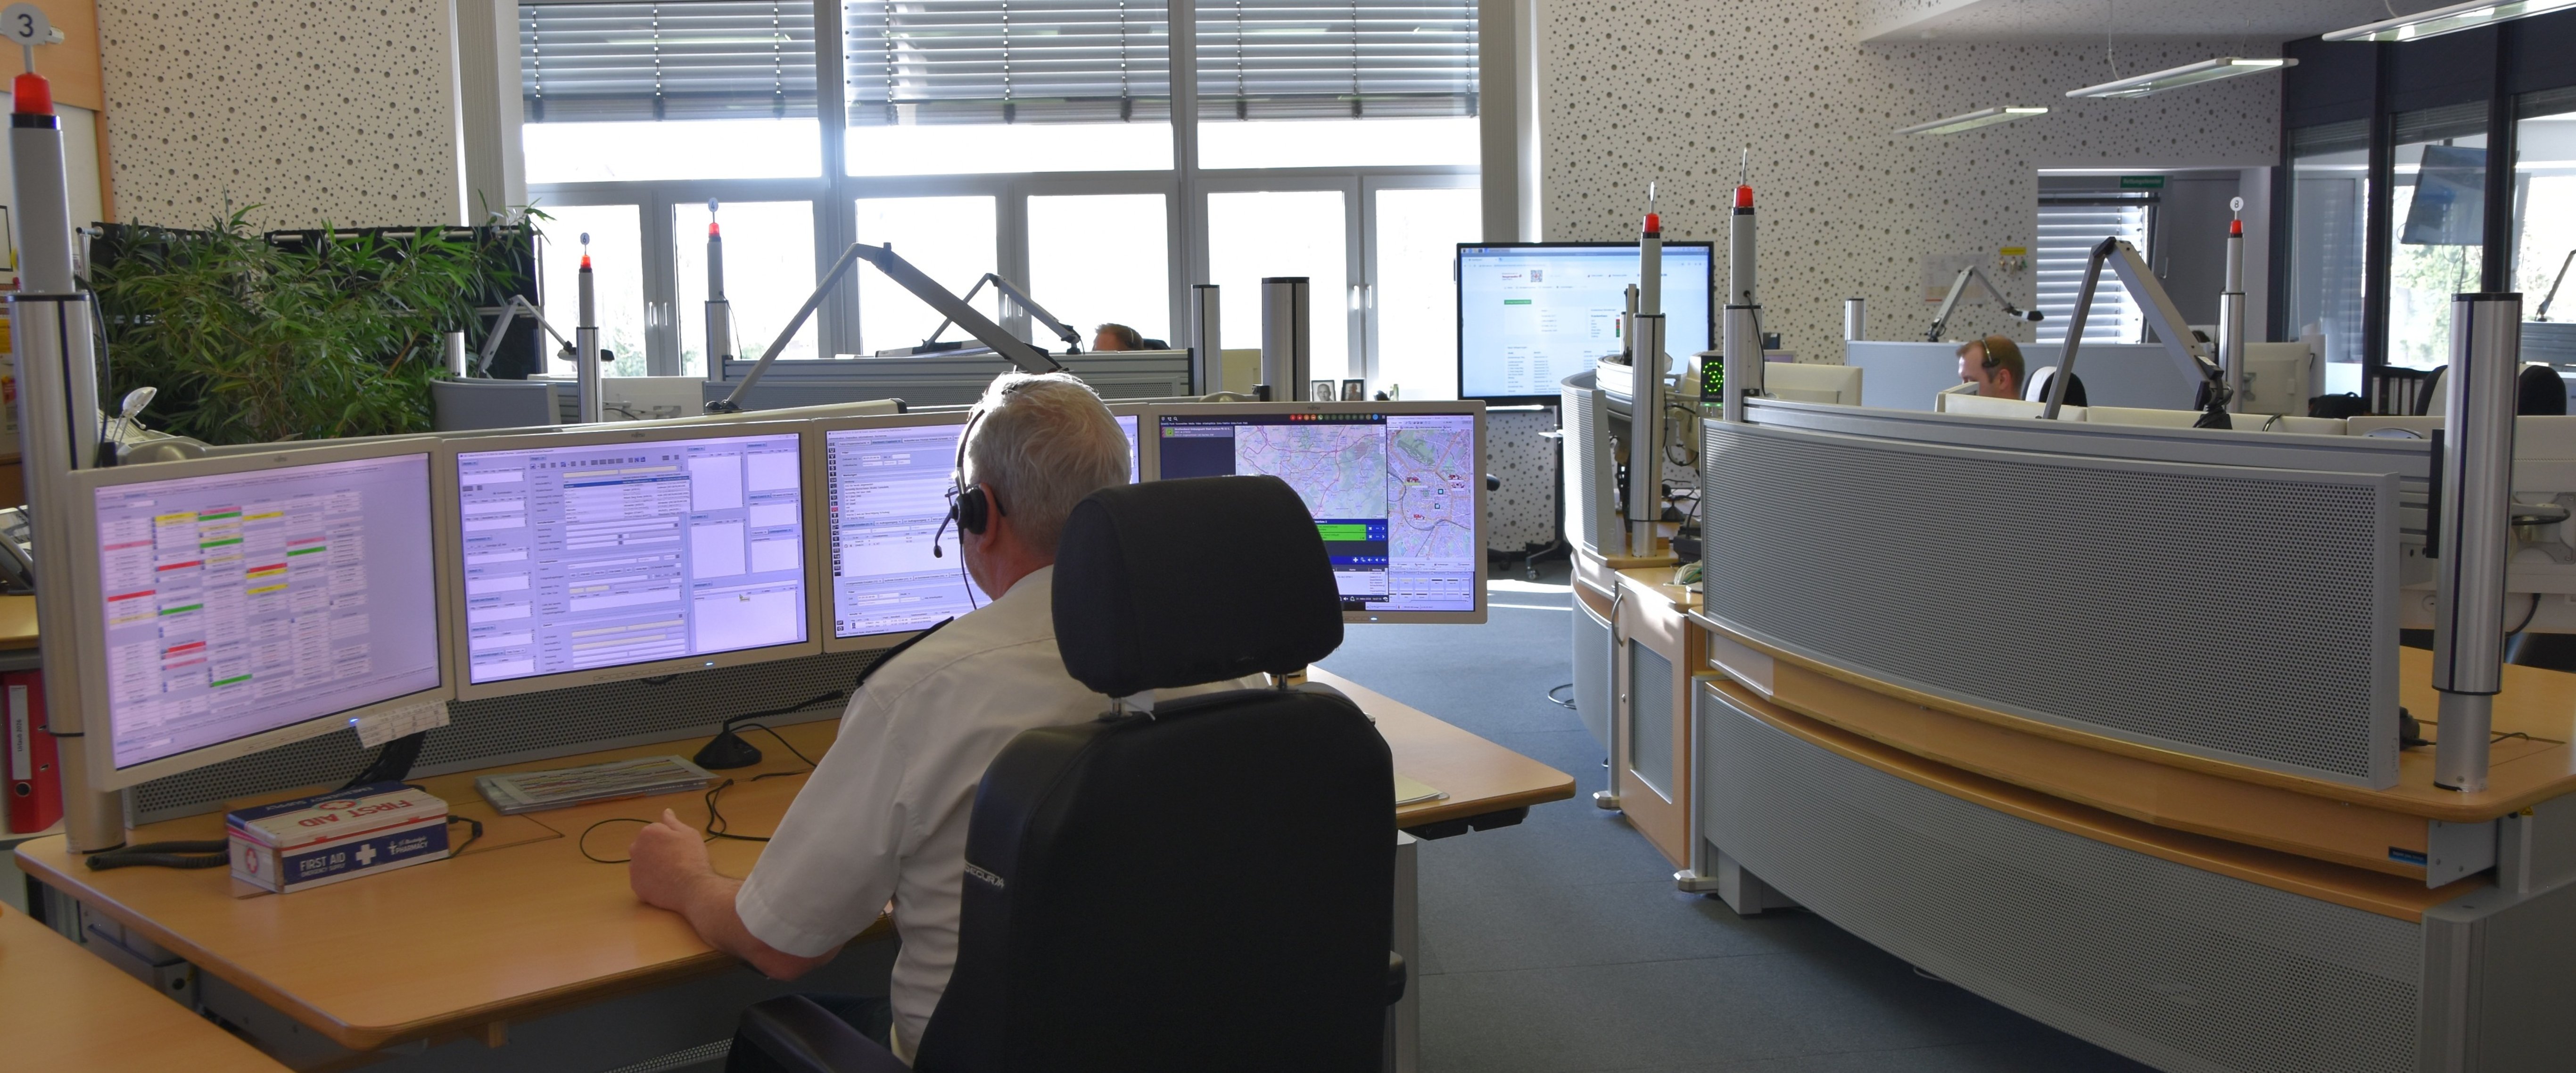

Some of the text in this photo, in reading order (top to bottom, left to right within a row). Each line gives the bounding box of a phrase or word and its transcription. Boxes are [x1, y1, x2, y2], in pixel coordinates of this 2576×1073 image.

[17, 14, 33, 38] 3
[2235, 200, 2239, 208] 8
[583, 235, 587, 243] 6
[298, 800, 413, 827] FIRST AID
[396, 841, 429, 854] PHARMACY
[300, 852, 346, 872] FIRST AID
